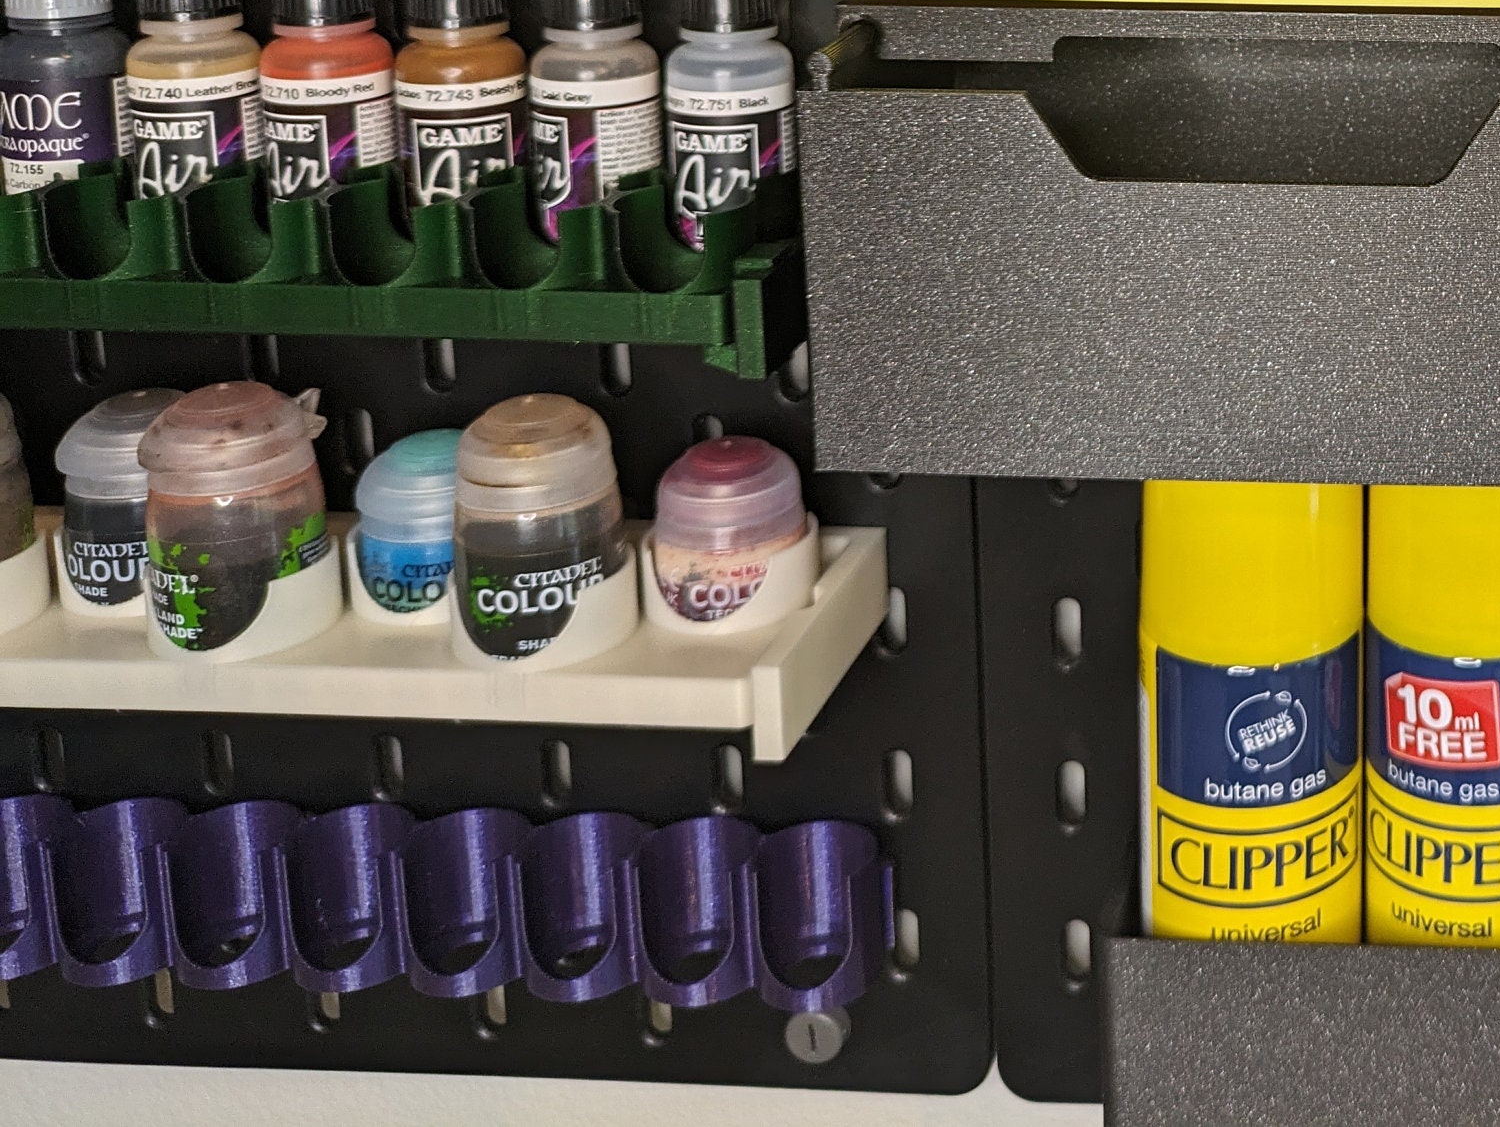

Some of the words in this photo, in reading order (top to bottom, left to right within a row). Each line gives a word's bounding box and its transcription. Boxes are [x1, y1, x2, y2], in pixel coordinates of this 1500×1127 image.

[139, 86, 182, 99] 72.740
[186, 82, 234, 97] Leather
[306, 84, 350, 98] Bloody
[353, 82, 375, 93] Red
[689, 99, 732, 112] 72.751
[739, 96, 770, 108] Black
[134, 119, 205, 140] GAME
[266, 123, 316, 143] AME
[419, 124, 504, 148] GAME
[675, 131, 750, 154] GAME
[10, 162, 44, 175] 72.155
[138, 141, 213, 199] Air
[674, 154, 758, 216] Air
[513, 555, 603, 588] CITADEL
[1238, 709, 1291, 740] RETHINK
[1396, 684, 1452, 732] 10
[1454, 710, 1480, 732] ml
[1242, 719, 1296, 755] REUSE
[1398, 726, 1489, 761] FREE
[1204, 777, 1285, 802] butane
[1289, 768, 1327, 799] gas
[1386, 760, 1455, 799] butane
[1458, 779, 1500, 805] gas
[1170, 814, 1349, 892] CLIPPER
[1210, 907, 1322, 942] universal
[1391, 900, 1493, 938] universal
